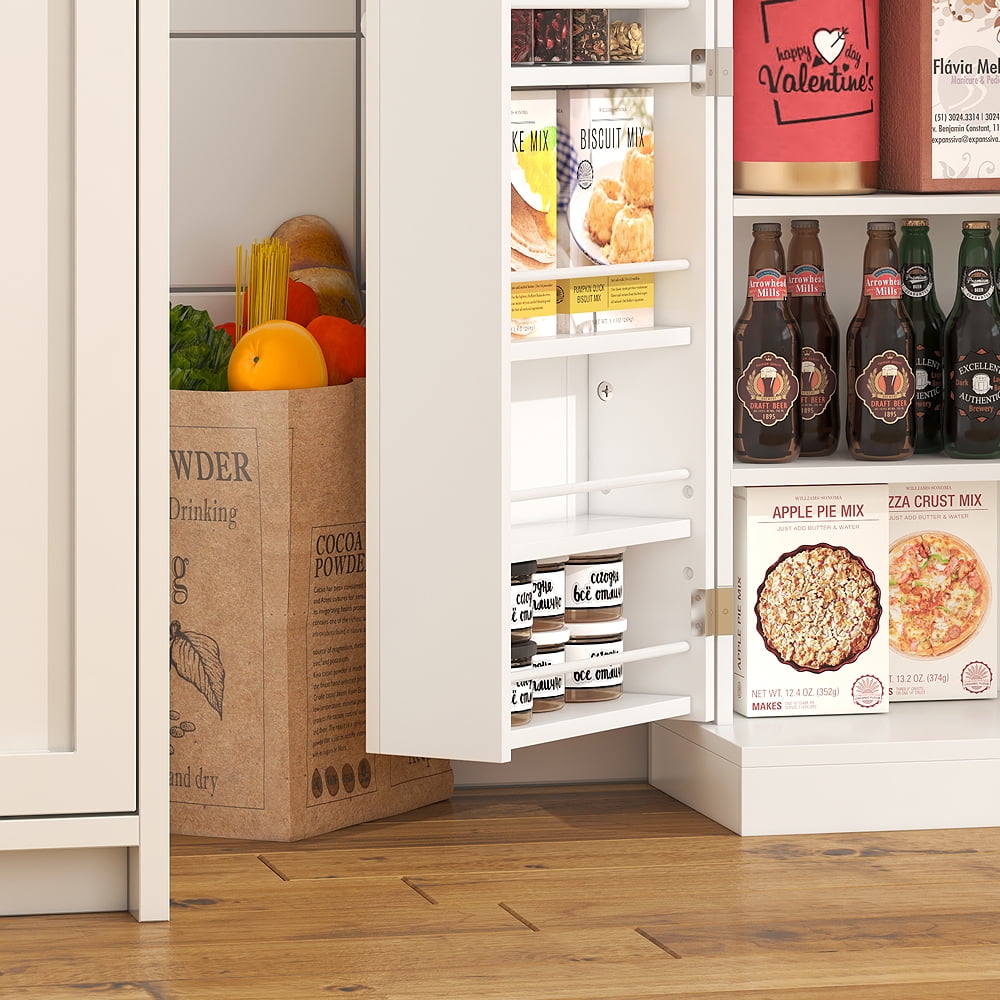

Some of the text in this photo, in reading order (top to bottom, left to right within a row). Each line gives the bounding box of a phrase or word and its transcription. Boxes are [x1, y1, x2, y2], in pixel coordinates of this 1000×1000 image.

[776, 44, 861, 69] happy day
[934, 58, 972, 74] Flávia
[759, 62, 874, 93] Valentine's
[939, 124, 990, 133] Benjamin Constant,
[531, 130, 548, 151] MIX
[581, 127, 645, 149] BISCUIT MIX
[573, 284, 605, 294] PUMPKIN QUICK
[758, 289, 780, 297] Mills
[796, 284, 818, 293] Mills
[876, 286, 897, 295] Mills
[577, 295, 593, 303] BISCUIT
[593, 294, 601, 302] MIX
[959, 391, 1000, 404] AUTHENTIC
[170, 450, 252, 481] WDER
[914, 494, 982, 507] CRUST MIX
[170, 497, 238, 529] Drinking
[773, 504, 864, 519] APPLE PIE MIX
[316, 531, 362, 555] COCOA
[314, 553, 366, 577] POWDE
[896, 673, 949, 683] 13.2 OZ. (374g)
[752, 687, 840, 698] NET WT. 12.4 OZ. (352g)
[752, 701, 782, 711] MAKES
[196, 767, 218, 796] dry
